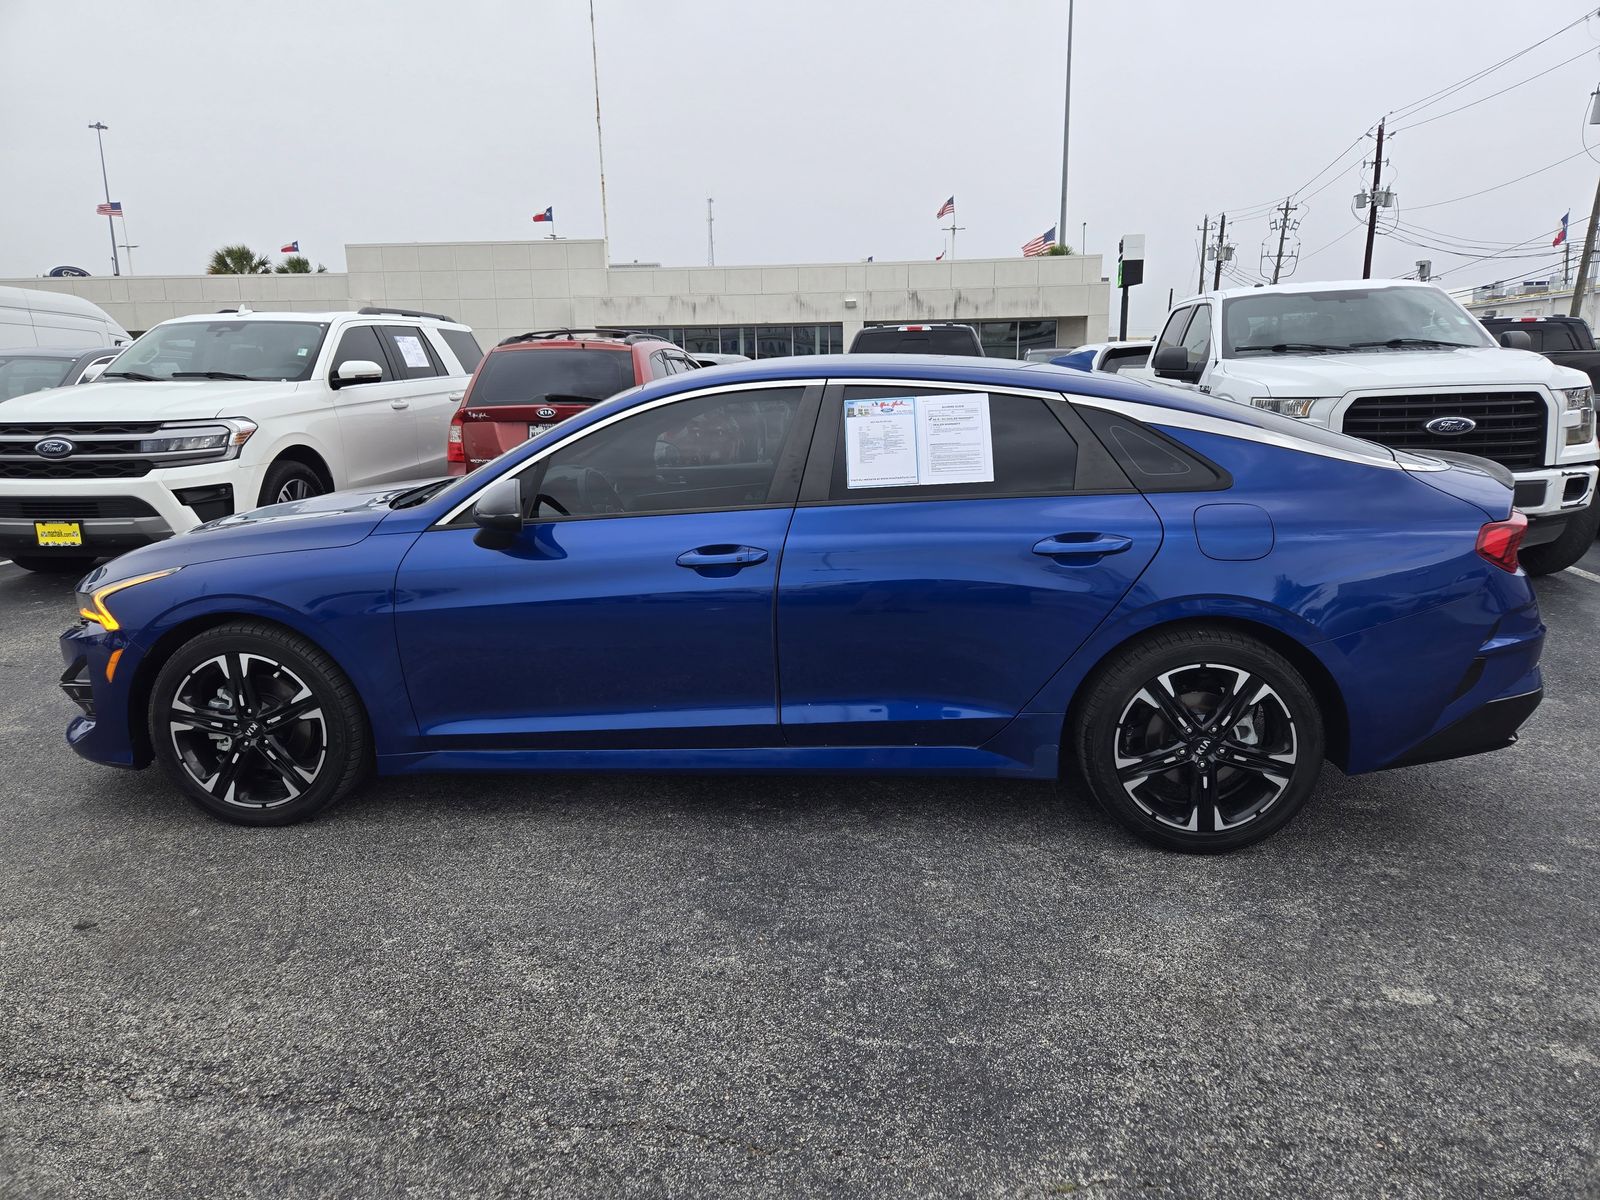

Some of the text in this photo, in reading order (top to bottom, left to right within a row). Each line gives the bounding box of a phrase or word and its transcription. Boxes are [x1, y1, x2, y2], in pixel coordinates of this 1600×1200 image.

[1438, 420, 1466, 431] Ford
[42, 442, 64, 452] Ford
[245, 722, 258, 736] KIA
[1195, 740, 1211, 755] KIA
